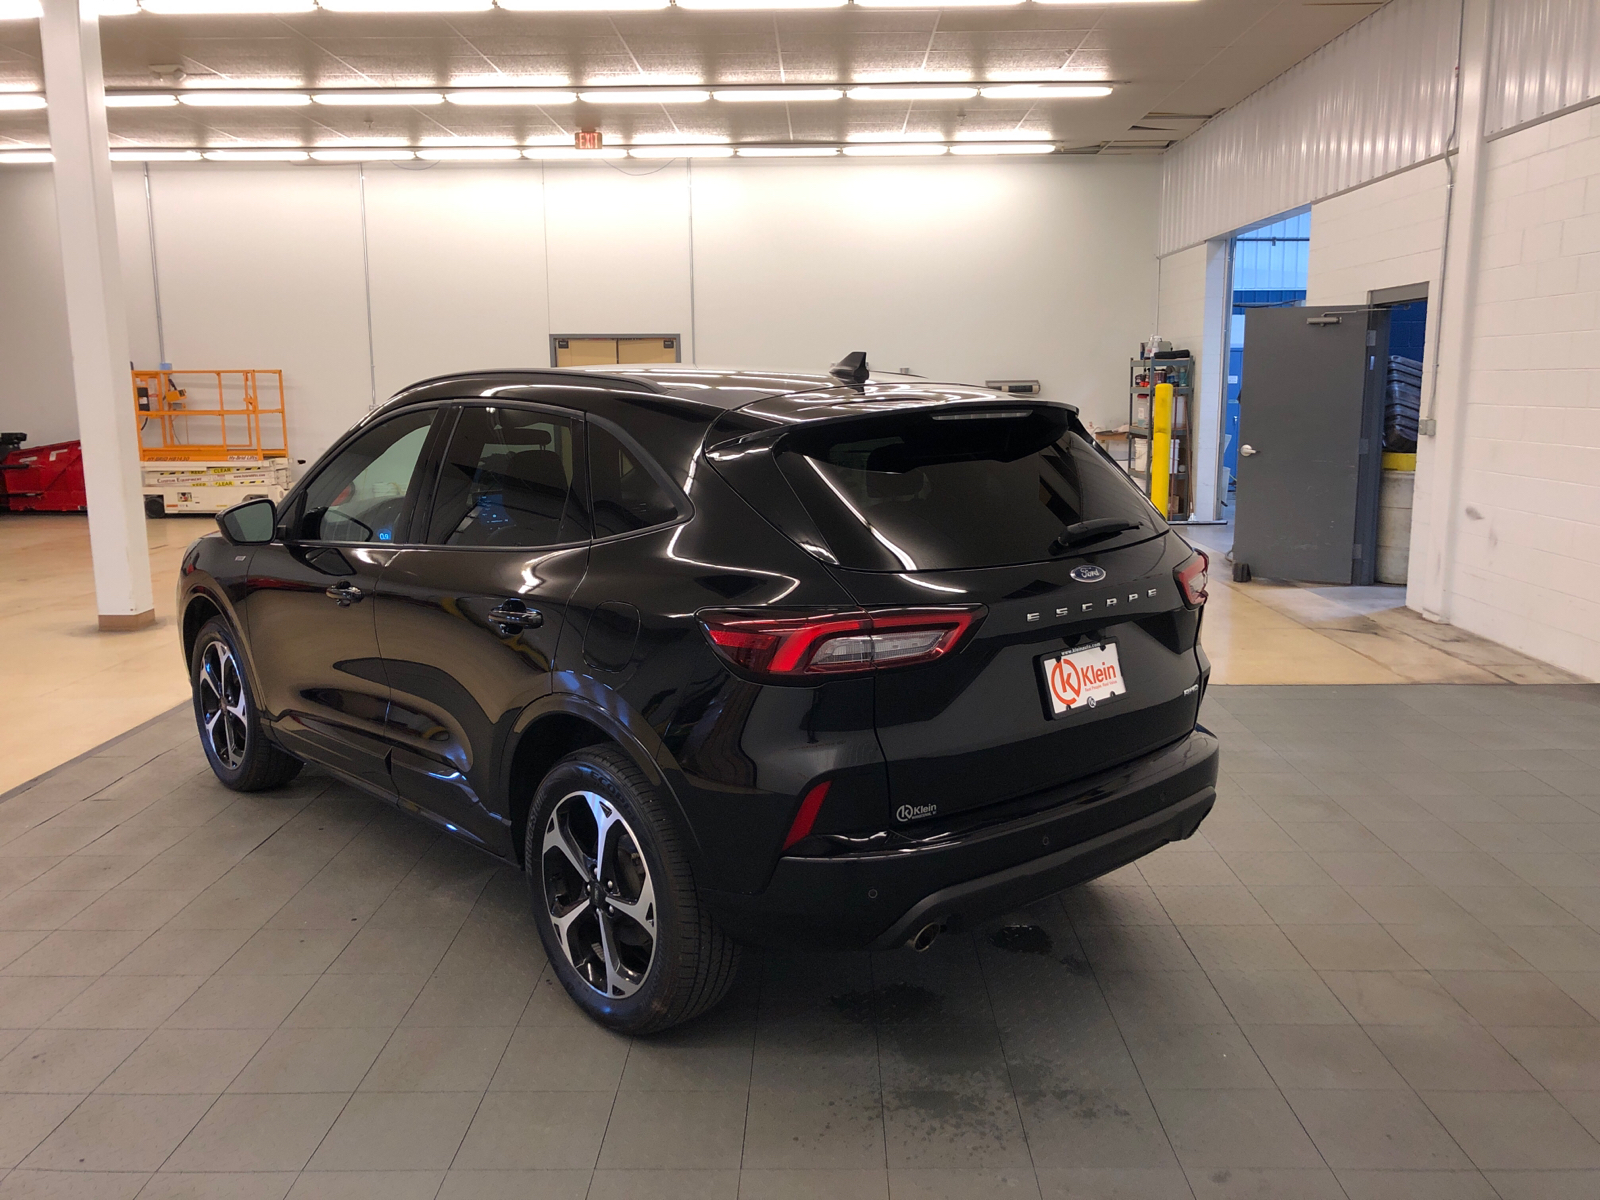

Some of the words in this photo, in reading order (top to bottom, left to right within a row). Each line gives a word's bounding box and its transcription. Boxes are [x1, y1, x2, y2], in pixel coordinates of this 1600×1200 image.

[579, 133, 598, 149] EXIT
[1080, 567, 1100, 578] Ford
[1026, 589, 1157, 622] ESCAPE
[1081, 661, 1117, 687] Klein
[913, 803, 937, 815] Klein
